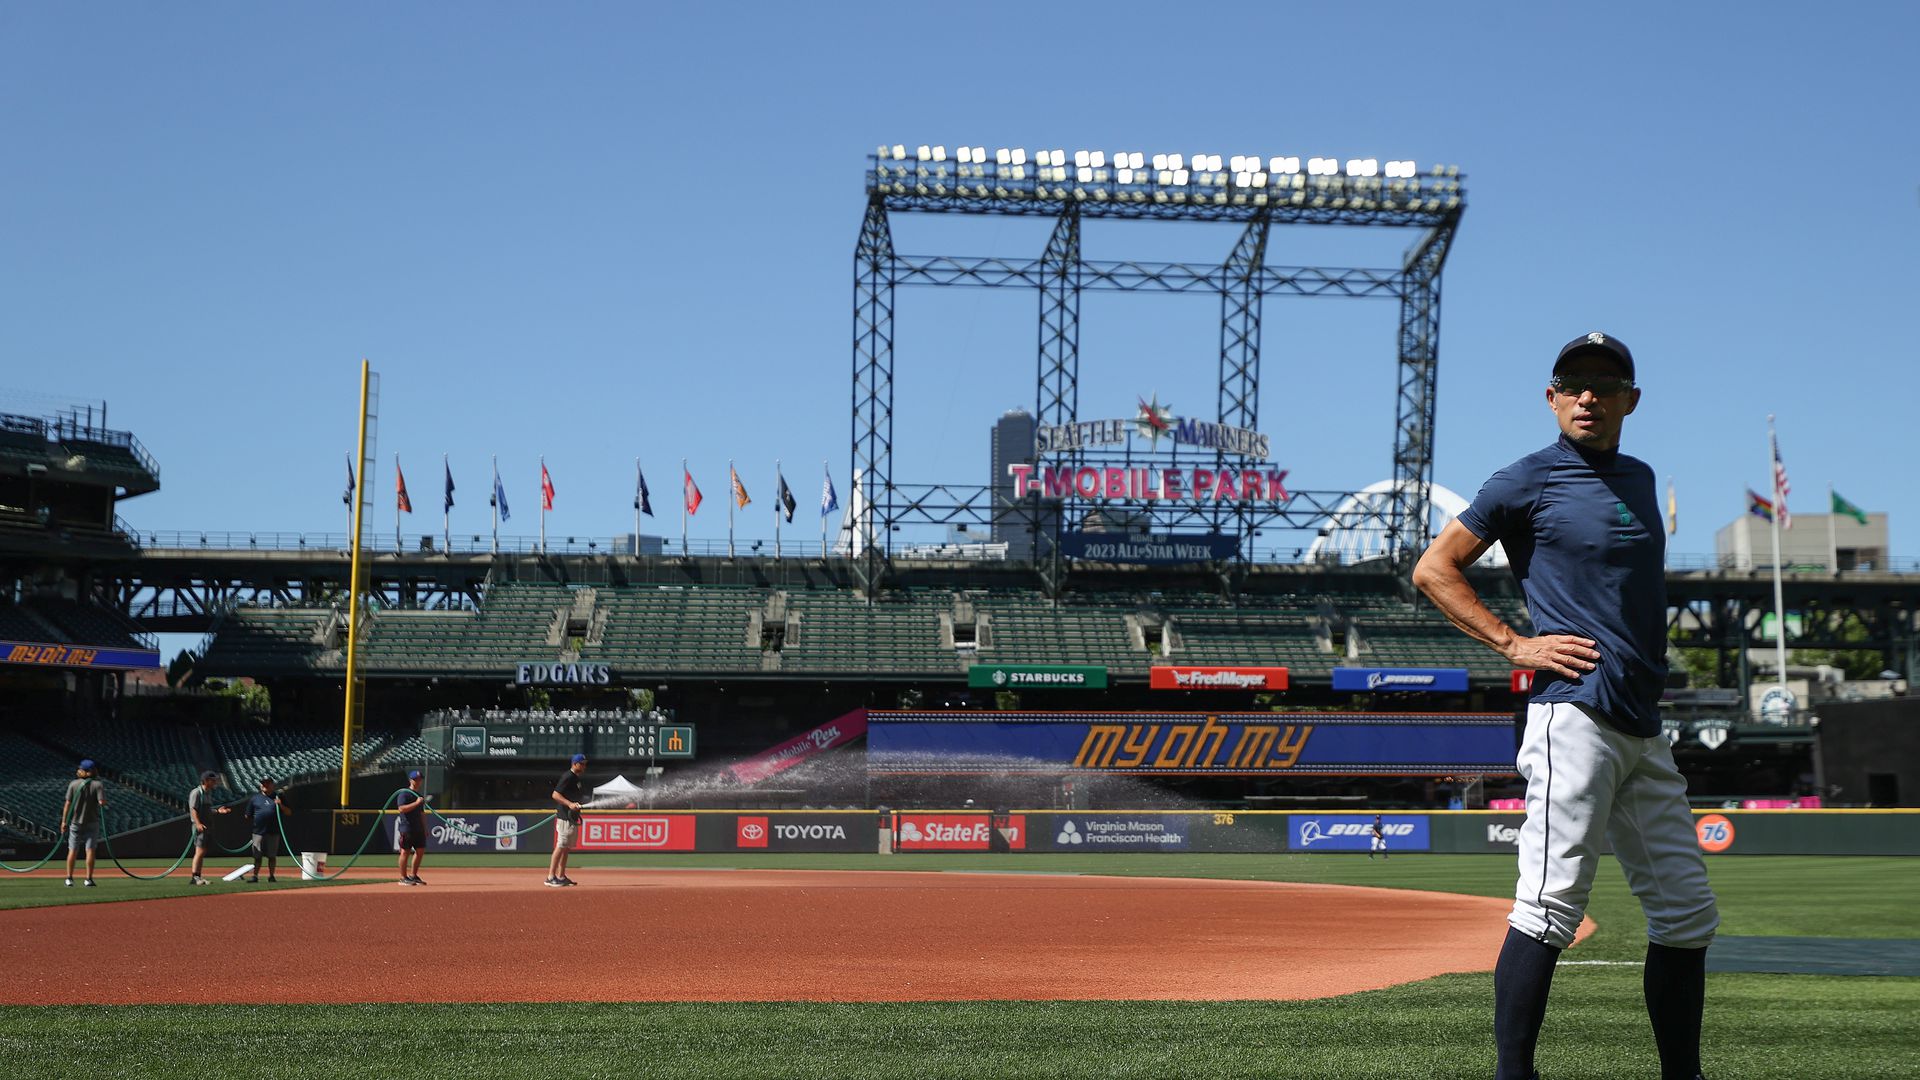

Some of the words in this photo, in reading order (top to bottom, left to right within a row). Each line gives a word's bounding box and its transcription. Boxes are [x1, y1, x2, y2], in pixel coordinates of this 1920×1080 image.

[1036, 418, 1125, 452] SEATTLE
[1176, 416, 1270, 459] MARINERS
[1008, 463, 1184, 500] T-MOBILE
[1191, 468, 1290, 501] PARK
[1084, 543, 1116, 559] 2023
[1176, 544, 1212, 560] WEEK
[1010, 671, 1085, 684] STARBUCKS
[489, 735, 511, 746] Tampa
[512, 735, 524, 746] Bay
[811, 726, 841, 749] Pen
[489, 747, 517, 756] Seattle
[341, 813, 360, 825] 331
[1213, 814, 1234, 825] 376
[774, 825, 846, 839] TOYOTA
[924, 822, 1019, 842] StateFa
[1086, 821, 1127, 834] Virginia
[1128, 821, 1164, 832] Mason
[1327, 823, 1415, 836] BOENG
[1703, 823, 1727, 841] 76
[1087, 833, 1143, 843] Franciscan
[1145, 833, 1181, 843] Health
